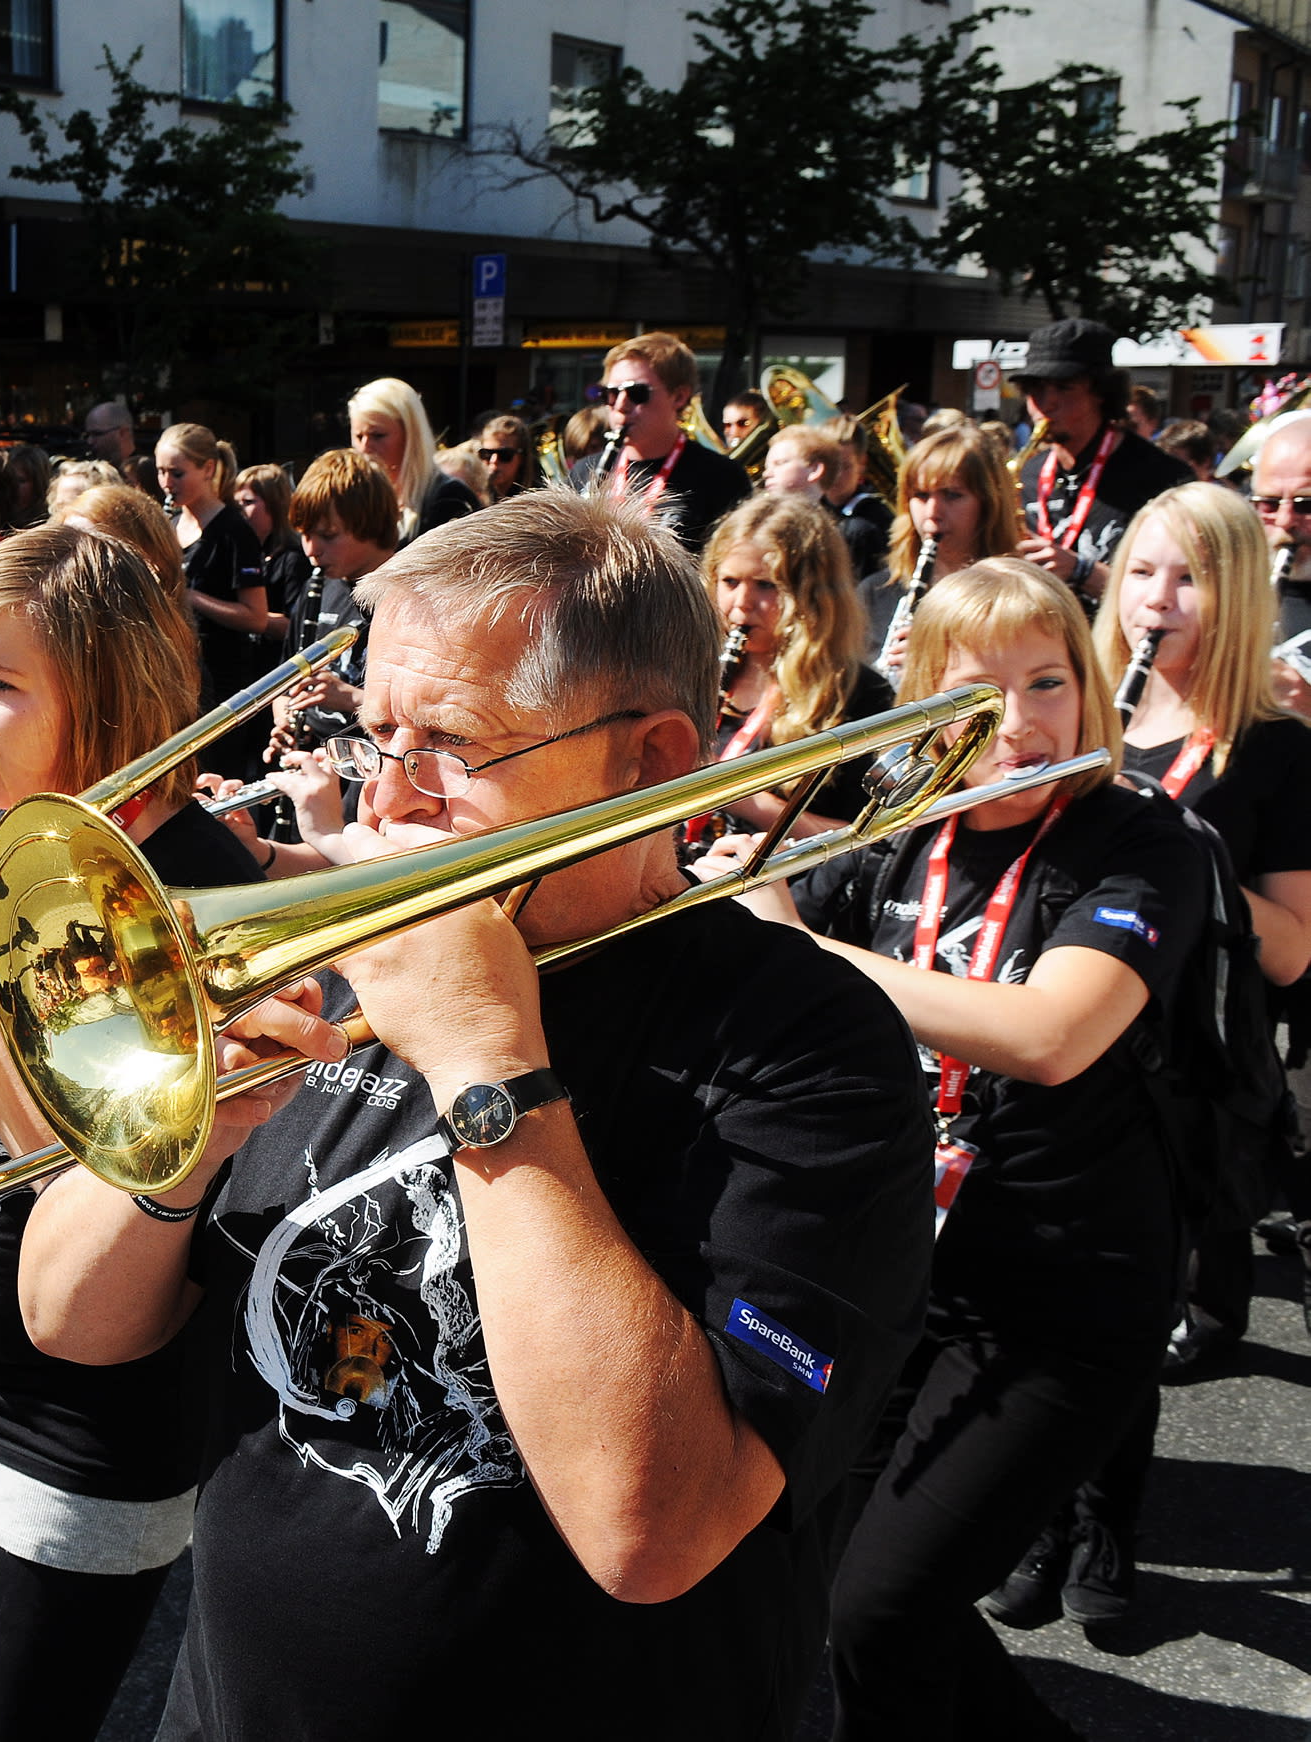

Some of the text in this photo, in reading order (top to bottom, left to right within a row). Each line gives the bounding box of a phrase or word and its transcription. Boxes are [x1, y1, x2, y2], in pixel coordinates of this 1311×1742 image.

[481, 261, 497, 293] P
[971, 920, 1002, 977] Dagbladet
[320, 1081, 344, 1096] juli
[357, 1091, 398, 1110] 2009
[738, 1308, 816, 1369] SpareBank
[792, 1361, 813, 1379] SMN
